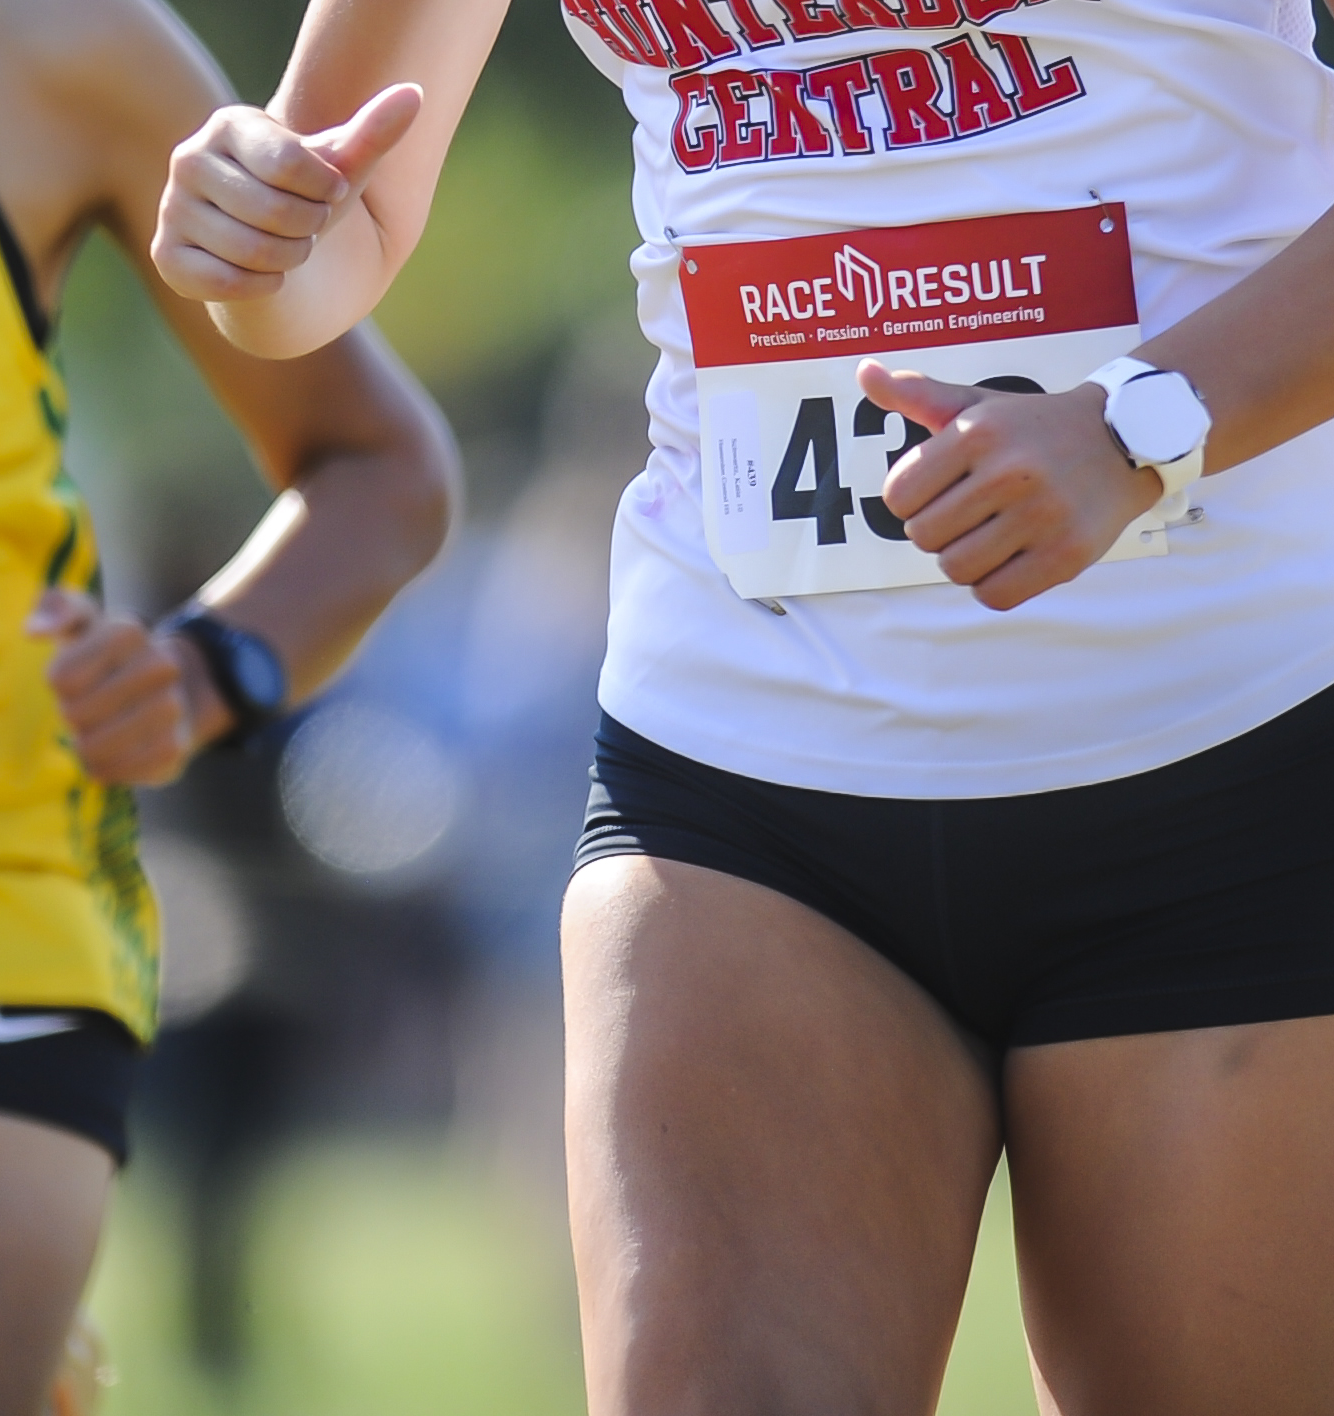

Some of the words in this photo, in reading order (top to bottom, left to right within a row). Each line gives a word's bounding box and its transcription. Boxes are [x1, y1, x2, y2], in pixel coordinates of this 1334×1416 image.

[668, 31, 1086, 174] CENTRAL
[739, 277, 836, 324] RACE
[887, 254, 1047, 310] RESULT
[749, 332, 806, 348] Precision
[816, 324, 870, 343] Passion
[883, 317, 944, 336] German
[948, 306, 1045, 330] Engineering
[771, 375, 1049, 546] 43
